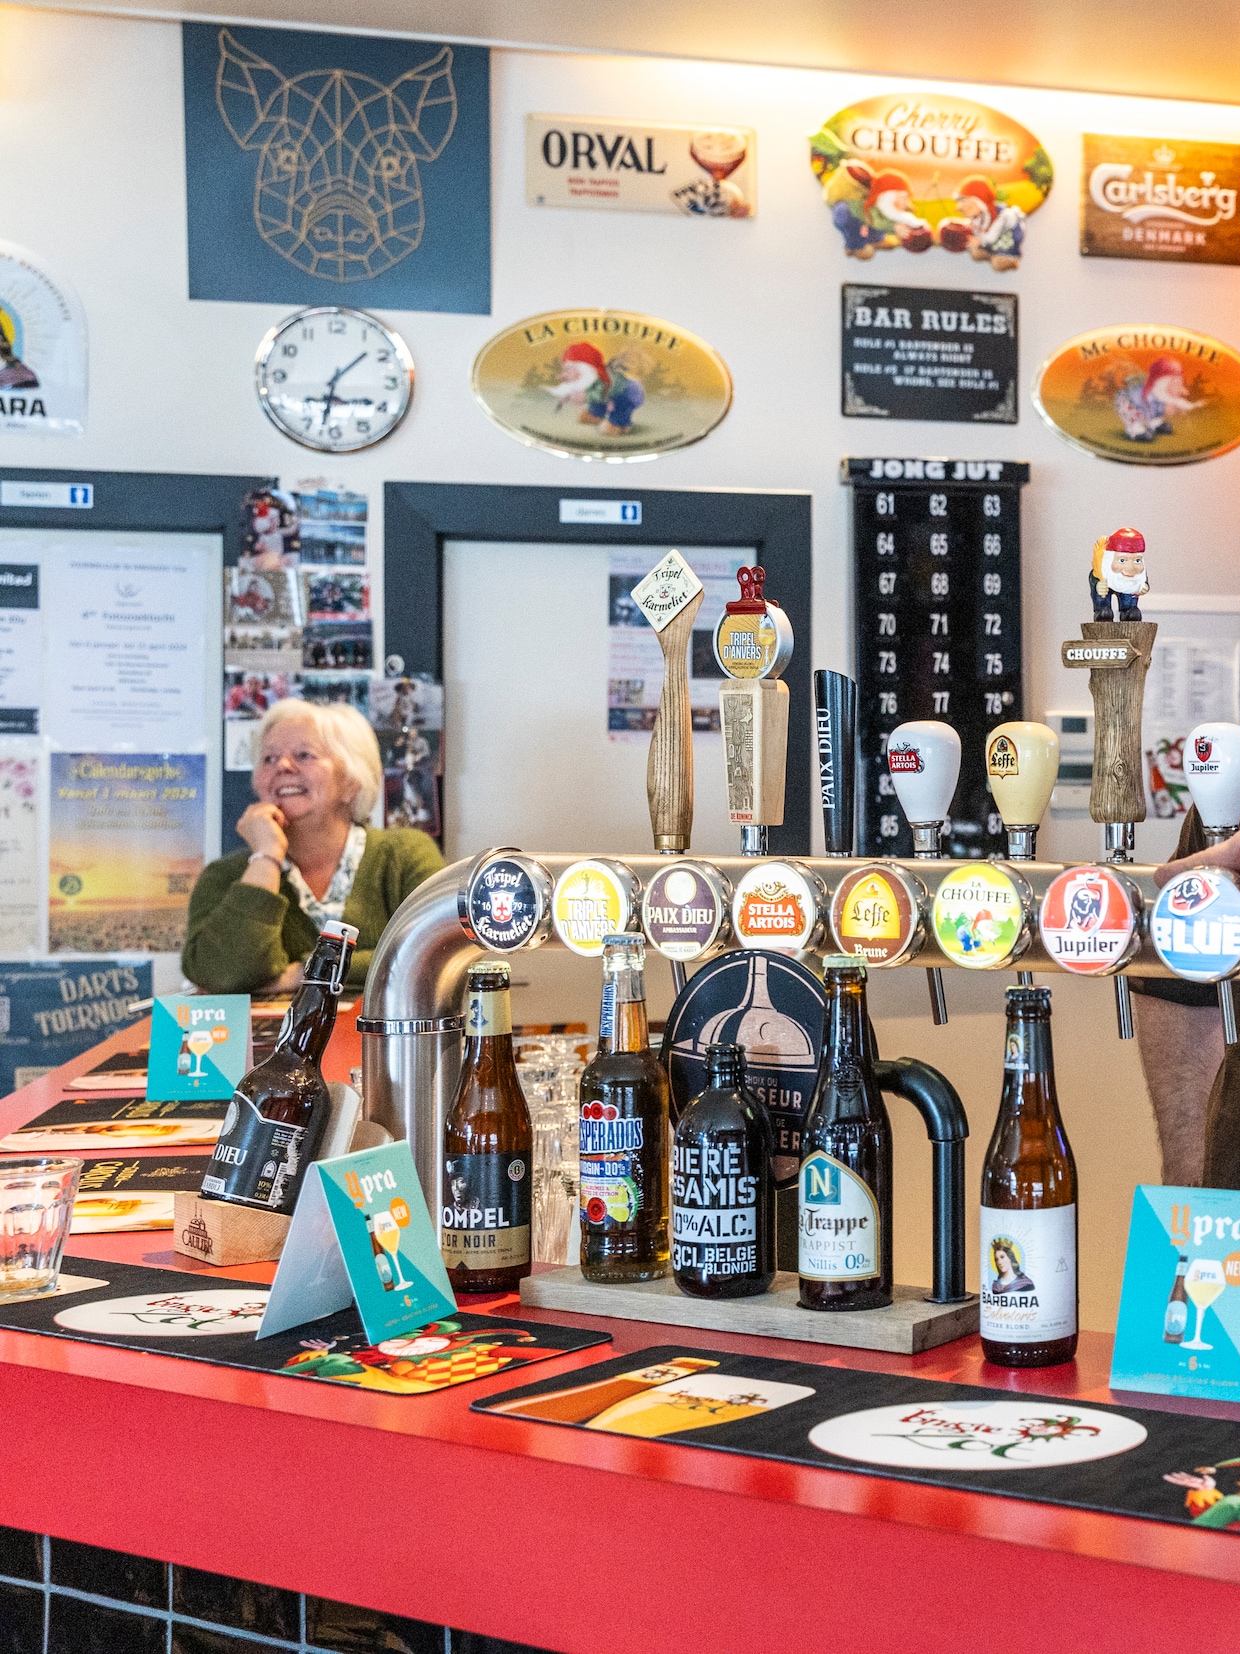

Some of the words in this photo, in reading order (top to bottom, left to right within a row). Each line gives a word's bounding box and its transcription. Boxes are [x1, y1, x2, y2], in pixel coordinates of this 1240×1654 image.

[884, 102, 982, 133] Cherry
[543, 130, 667, 174] ORVAL
[851, 127, 1013, 164] CHOUFFE
[1089, 163, 1237, 223] Carlsberg
[1122, 226, 1206, 246] DENMARK
[855, 306, 912, 330] BAR
[921, 309, 1007, 335] RULES
[524, 323, 556, 346] LA
[563, 317, 683, 350] CHOUFFE
[1081, 341, 1108, 361] Mc
[1117, 333, 1221, 364] CHOUFFE
[870, 460, 946, 480] JONG
[952, 462, 1004, 481] JUT
[876, 492, 895, 515] 61
[929, 494, 947, 516] 62
[983, 494, 1001, 517] 63
[876, 532, 894, 555] 64
[930, 533, 948, 556] 65
[983, 533, 1001, 556] 66
[652, 567, 684, 582] Tripel
[879, 572, 897, 594] 67
[931, 572, 949, 595] 68
[983, 573, 1001, 596] 69
[642, 592, 688, 612] Karmeliet
[878, 613, 896, 636] 70
[930, 613, 949, 636] 71
[983, 613, 1002, 636] 72
[729, 632, 756, 646] TRIPEL
[723, 645, 762, 660] D'ANVERS
[878, 651, 897, 674] 73
[932, 652, 950, 674] 74
[984, 653, 1003, 675] 75
[1066, 648, 1128, 661] CHOUFFE
[879, 692, 898, 715] 76
[932, 691, 950, 714] 77
[984, 692, 1003, 715] 78
[816, 707, 833, 754] DIEU
[891, 754, 916, 762] STELLA
[991, 752, 1016, 769] Leffe
[1191, 762, 1219, 773] Jupiler
[821, 760, 836, 810] PAIX
[880, 814, 899, 838] 85
[483, 866, 524, 889] Tripel
[971, 881, 982, 889] LA
[482, 901, 491, 912] 16
[513, 901, 523, 912] 79
[941, 888, 1012, 905] CHOUFFE
[568, 899, 608, 921] TRIPLE
[648, 907, 679, 924] PAIX
[682, 908, 714, 926] DIEU
[748, 903, 795, 917] STELLA
[851, 900, 891, 928] Leffe
[475, 914, 533, 942] Karmeliet
[560, 919, 617, 941] D'ANVERS
[662, 926, 698, 934] AMBASSADEUR
[748, 916, 796, 929] ARTOIS
[853, 943, 889, 958] Brune
[1055, 936, 1120, 957] Jupiler
[59, 966, 140, 1004] DARTS
[212, 1029, 228, 1039] NEW
[745, 1074, 765, 1086] HOIX
[580, 1120, 643, 1152] SPERADOS
[216, 1143, 248, 1167] DIEU
[808, 1164, 833, 1198] N
[391, 1204, 408, 1222] NEW
[441, 1202, 510, 1229] OMPEL
[804, 1208, 869, 1237] Trappe
[464, 1234, 496, 1249] NOIR
[705, 1245, 757, 1263] BELGE
[808, 1258, 838, 1271] Nillis
[705, 1260, 757, 1276] BLONDE
[982, 1291, 1040, 1309] BARBARA
[1006, 1322, 1031, 1331] BLOND
